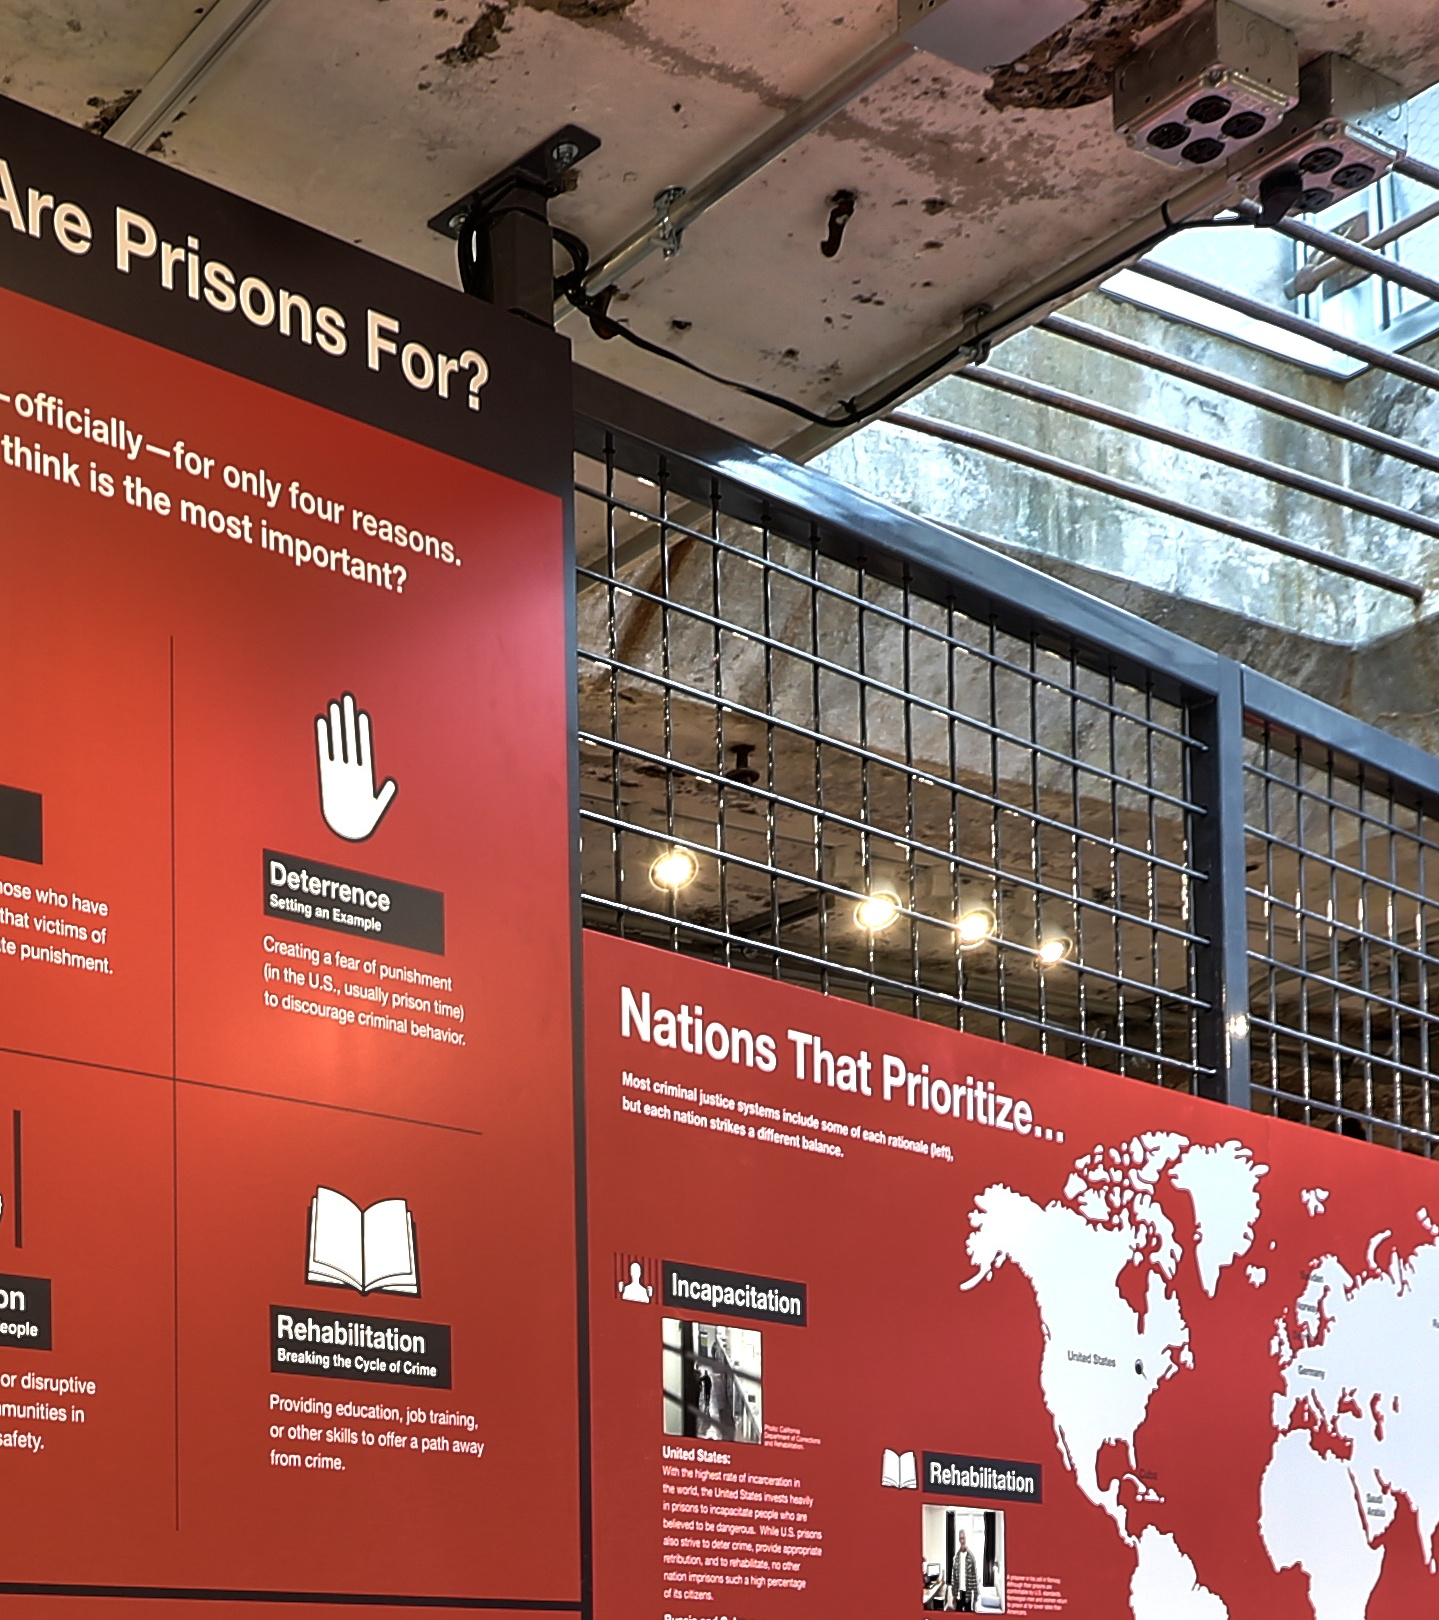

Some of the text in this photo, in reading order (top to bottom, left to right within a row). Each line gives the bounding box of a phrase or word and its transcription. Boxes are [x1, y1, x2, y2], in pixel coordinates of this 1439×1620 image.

[117, 207, 346, 355] Prisons
[368, 310, 488, 410] For?
[224, 466, 281, 507] only
[289, 482, 344, 523] four
[353, 510, 461, 566] reasons.
[271, 861, 390, 911] Deterrence
[270, 895, 381, 931] Setting an Example
[622, 987, 1063, 1142] Nations That Prioritize...
[673, 1273, 800, 1315] Incapacitation
[278, 1315, 424, 1353] Rehabilitation
[278, 1348, 436, 1376] Breaking the Cycle of Crime
[1068, 1351, 1116, 1367] United States
[663, 1447, 730, 1464] United States:
[930, 1463, 1033, 1493] Rehabilitation
